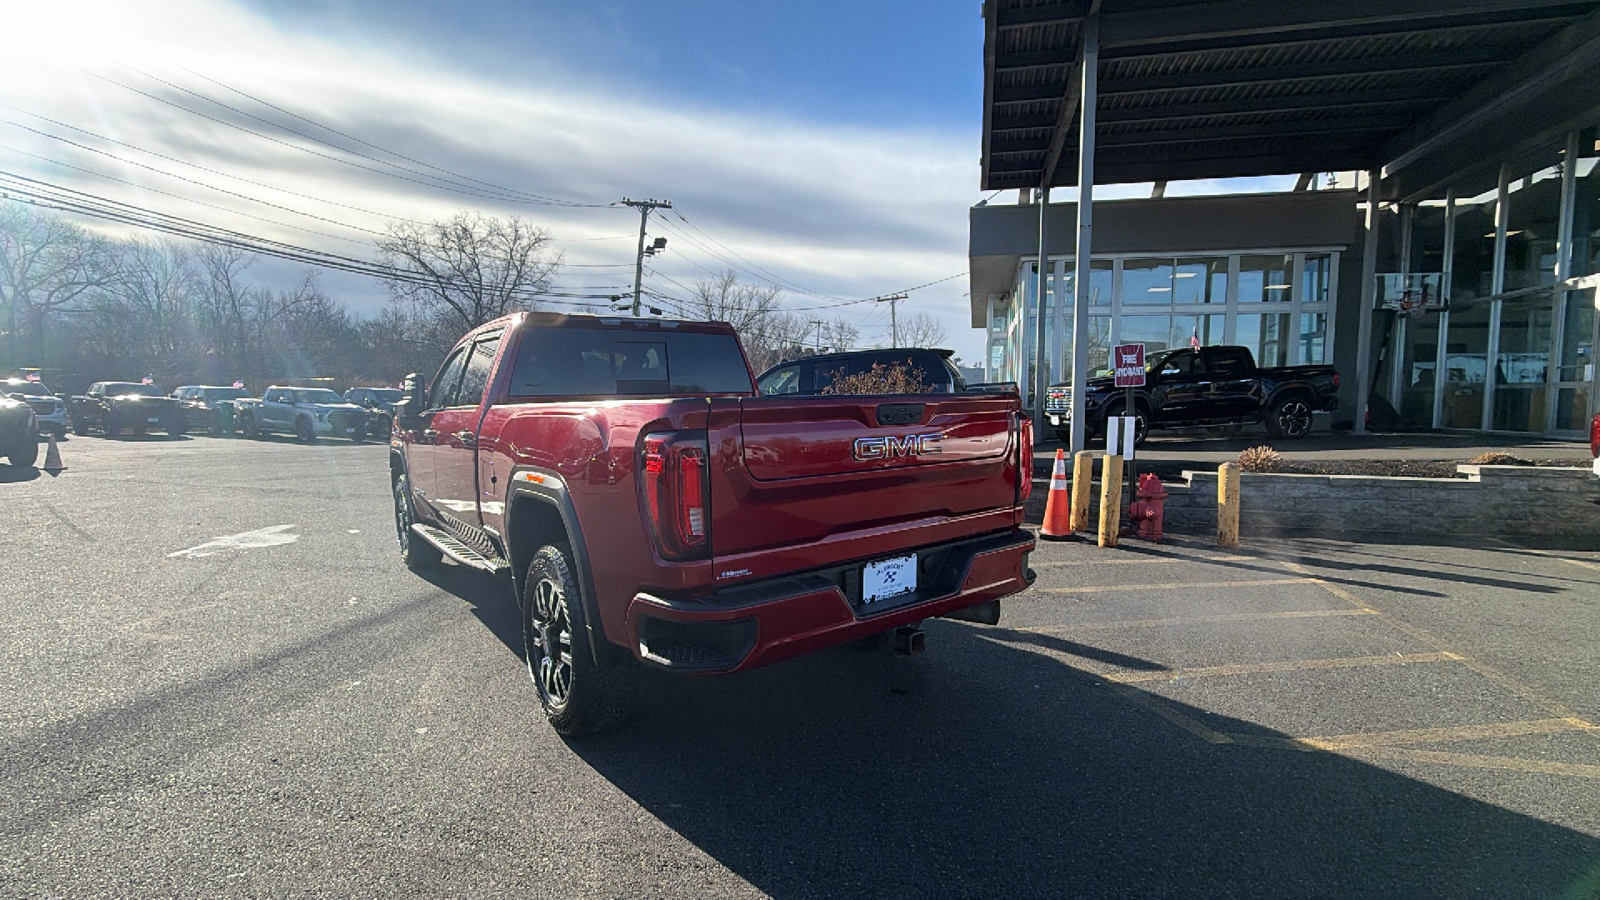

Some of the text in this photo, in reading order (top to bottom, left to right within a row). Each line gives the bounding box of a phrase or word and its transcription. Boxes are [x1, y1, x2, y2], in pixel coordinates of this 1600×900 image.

[1122, 354, 1137, 364] FIRE
[1116, 366, 1144, 377] HYDRANT
[854, 433, 943, 461] GMC
